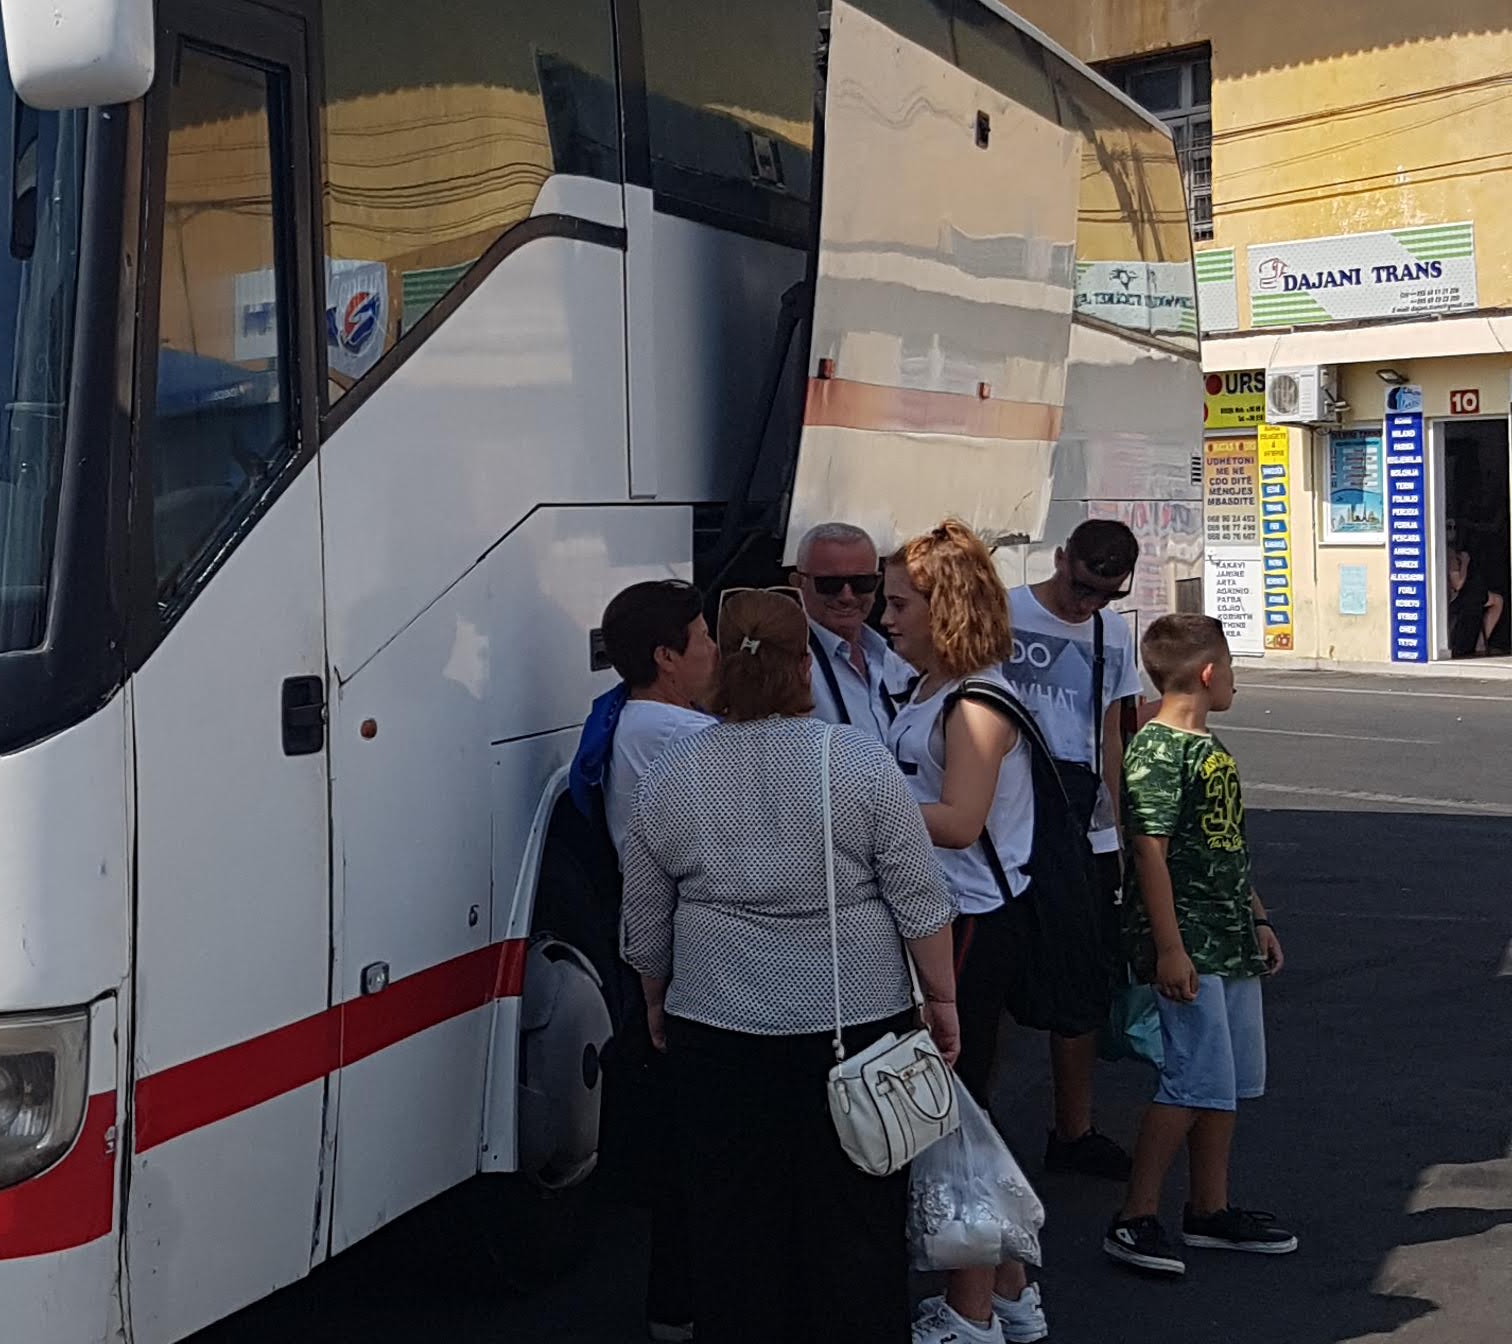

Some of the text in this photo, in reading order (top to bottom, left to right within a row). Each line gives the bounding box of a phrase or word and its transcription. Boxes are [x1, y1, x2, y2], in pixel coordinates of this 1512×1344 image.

[1283, 260, 1443, 292] DAJANI TRANS
[1452, 392, 1477, 412] 10
[1009, 638, 1051, 668] DO
[1010, 680, 1079, 713] WHAT
